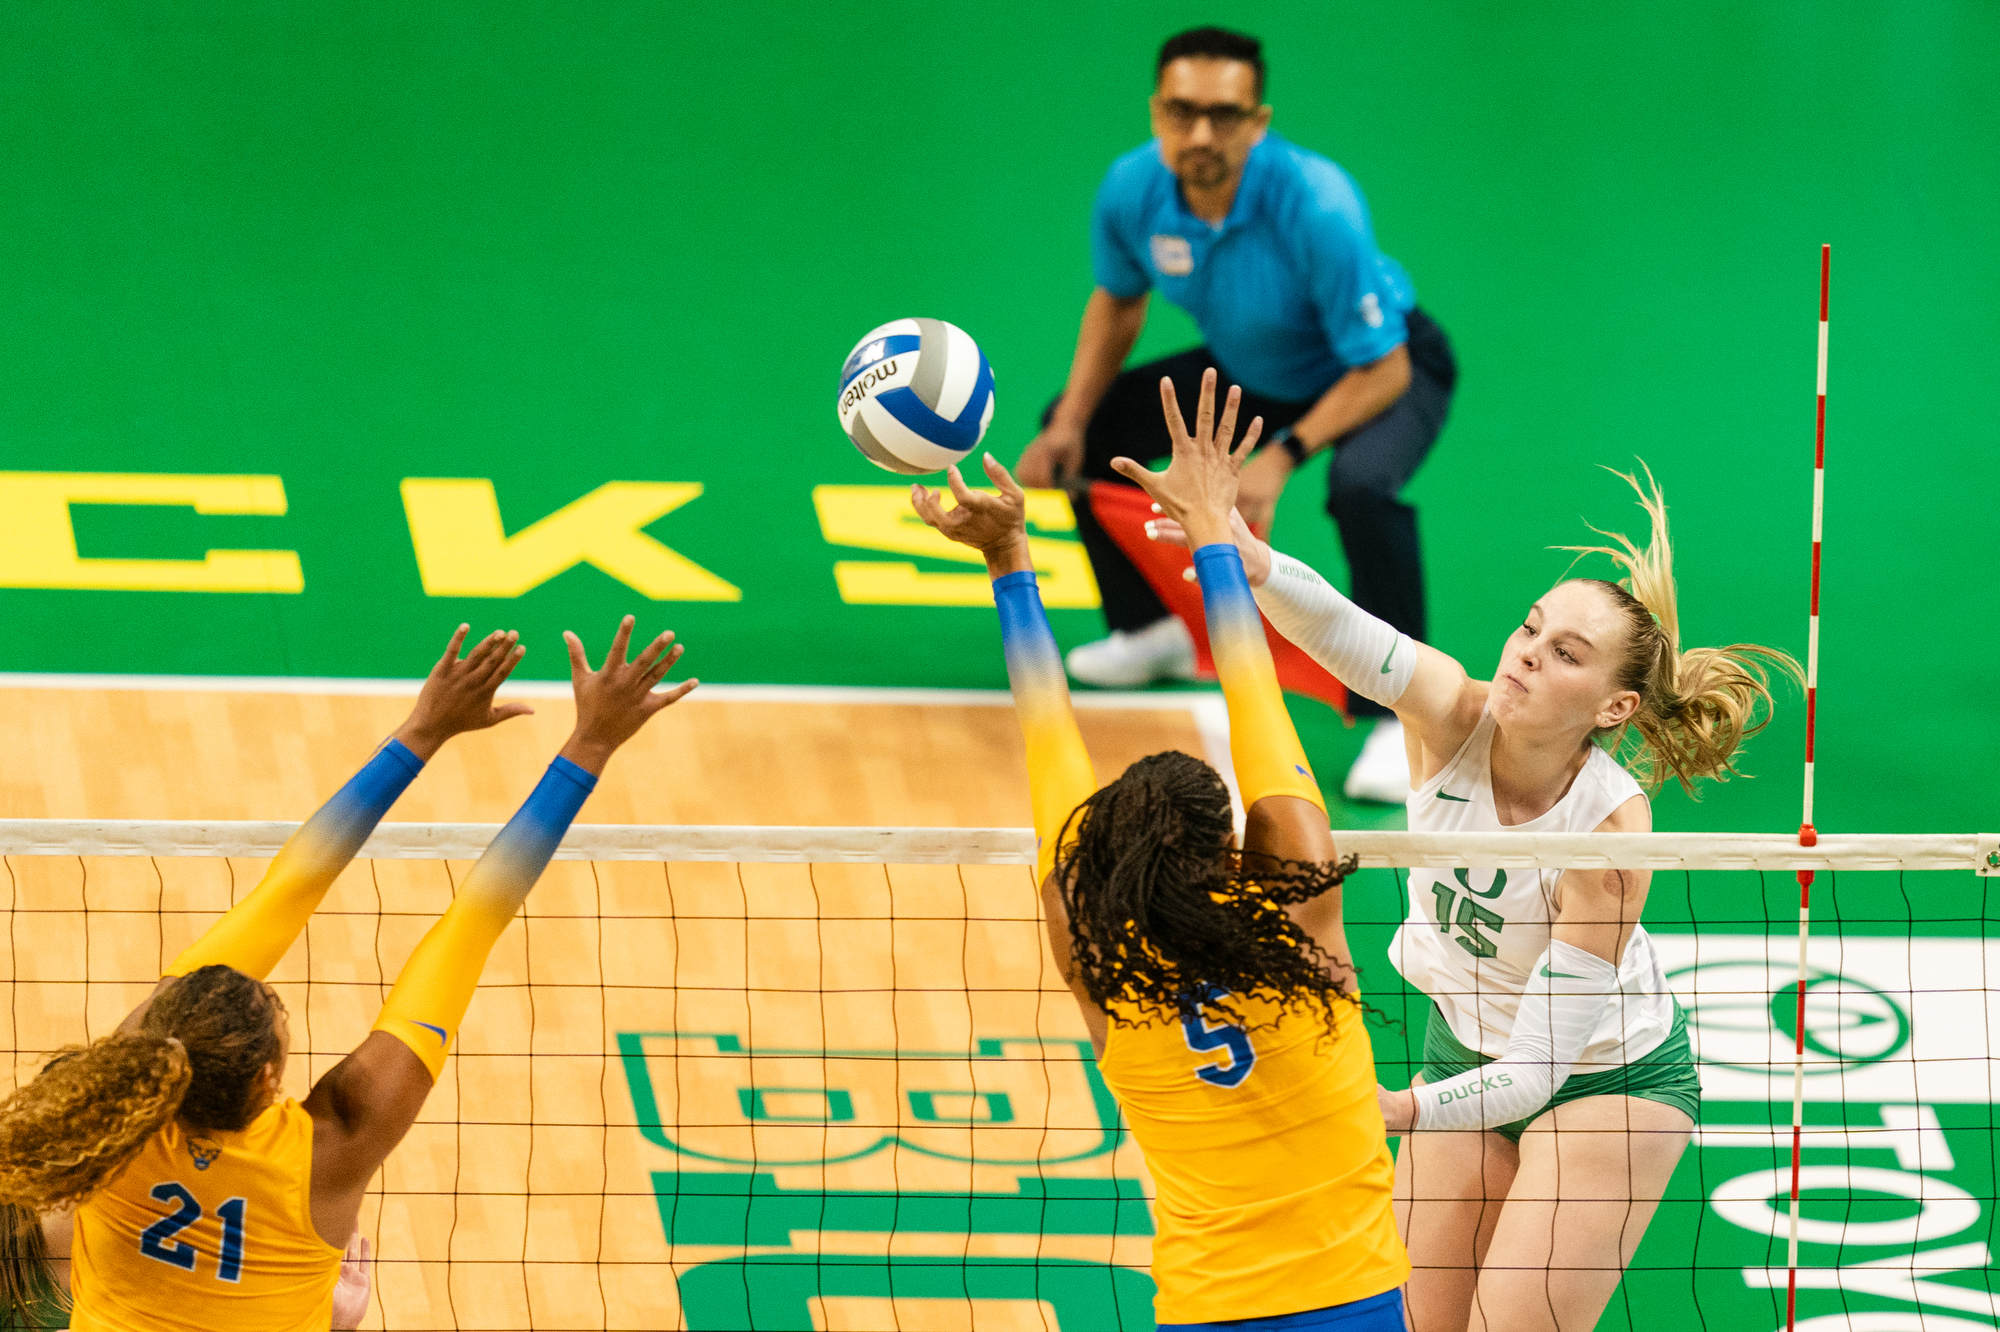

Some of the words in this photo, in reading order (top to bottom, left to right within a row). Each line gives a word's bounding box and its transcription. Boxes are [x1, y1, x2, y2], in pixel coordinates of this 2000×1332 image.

[840, 360, 898, 416] molten
[1278, 562, 1321, 585] OREGON
[1431, 881, 1505, 958] 15
[1178, 980, 1258, 1089] 5
[1437, 1072, 1513, 1106] DUCKS
[139, 1181, 247, 1283] 21
[1691, 1105, 2000, 1332] TOY
